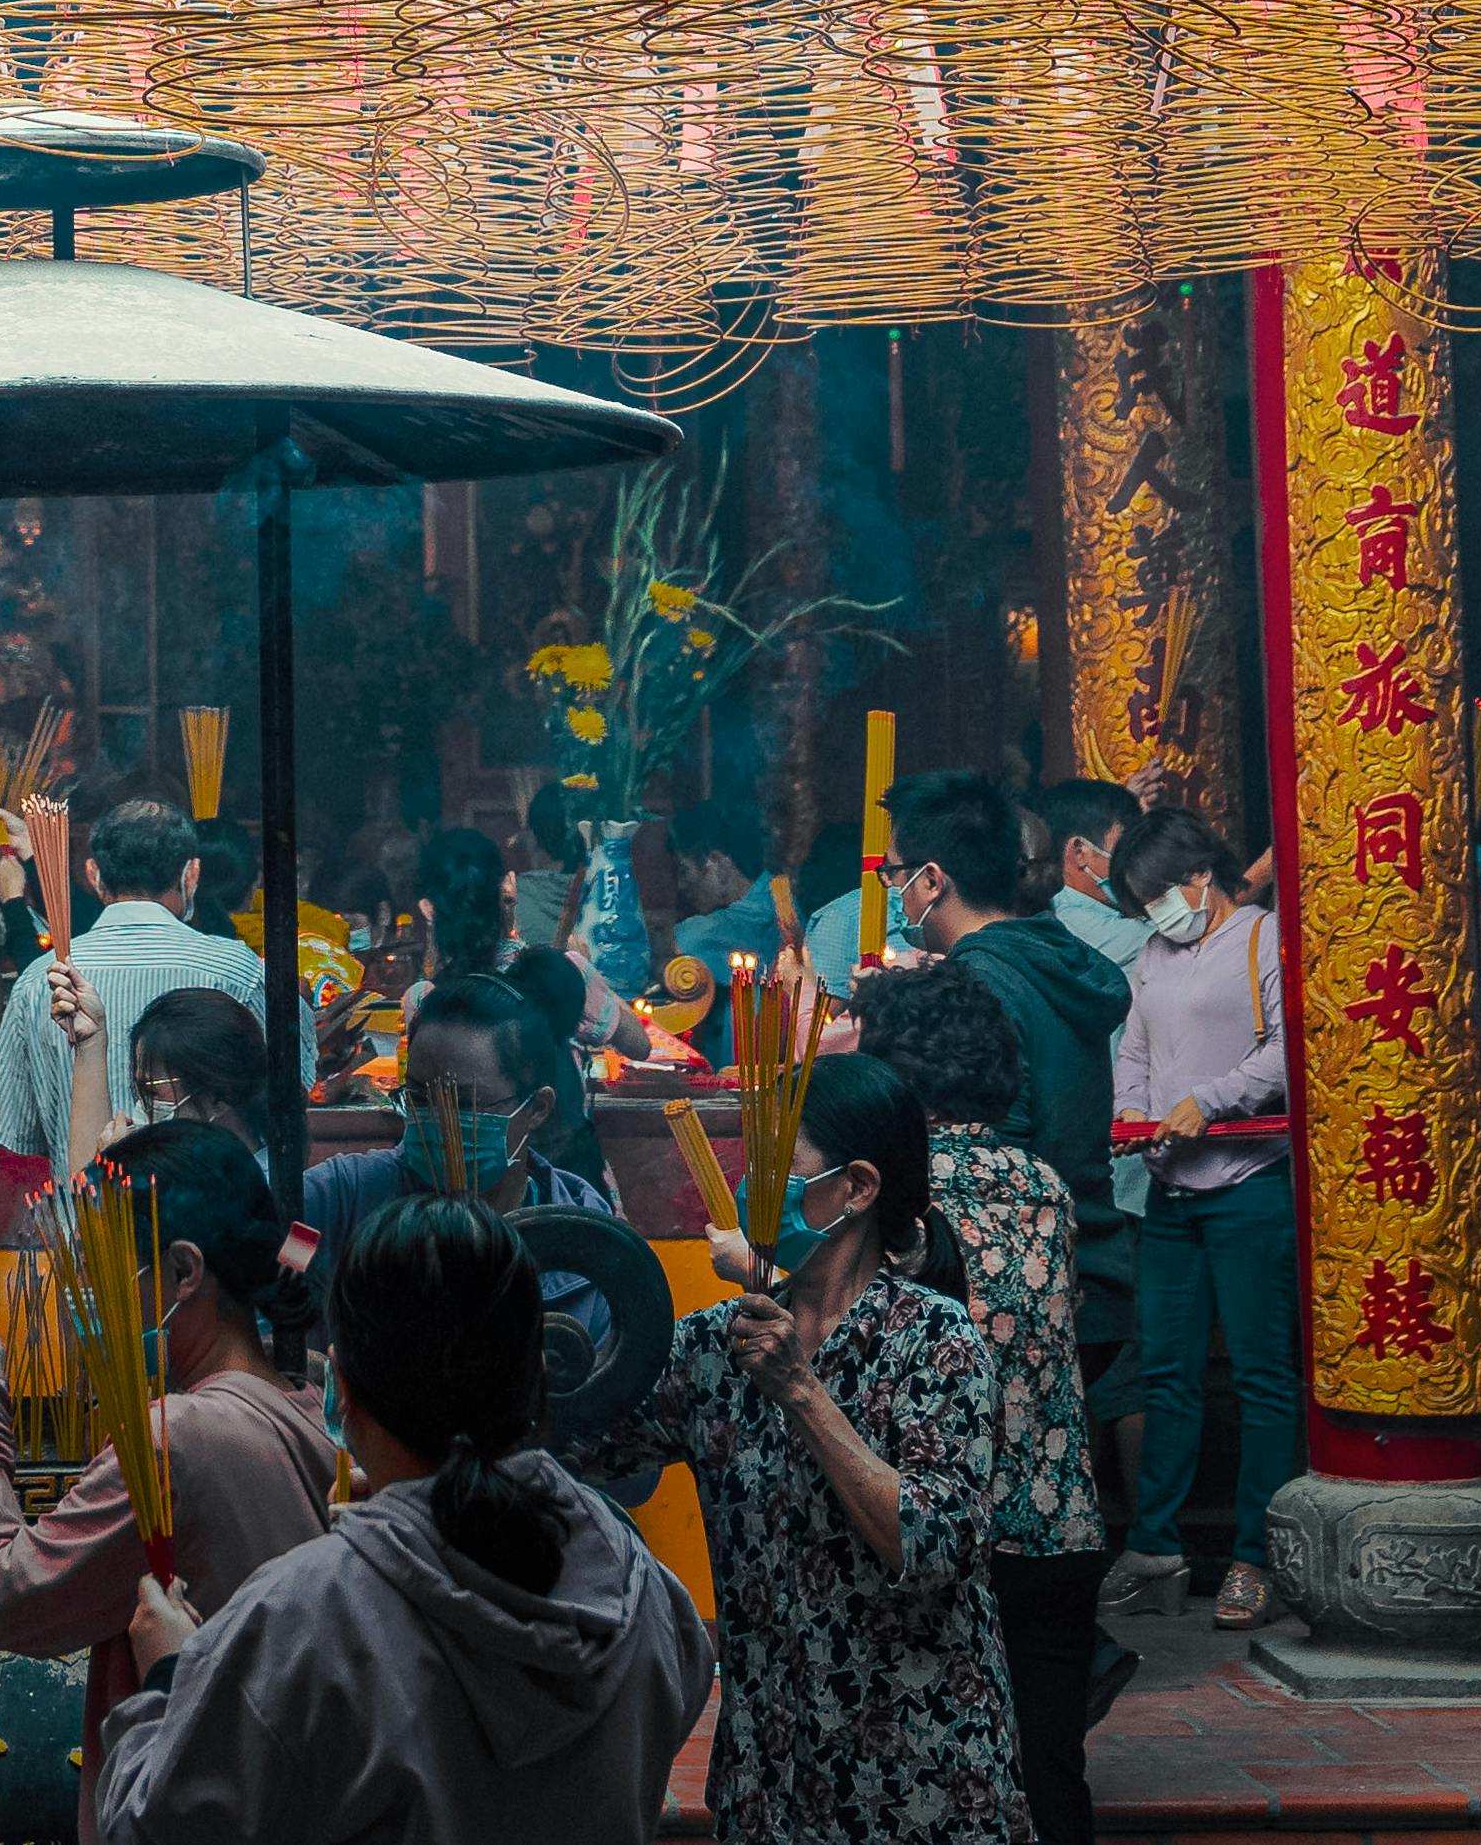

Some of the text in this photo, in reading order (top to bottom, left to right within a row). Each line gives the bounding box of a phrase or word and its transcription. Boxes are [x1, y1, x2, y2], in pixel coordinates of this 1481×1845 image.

[1337, 235, 1454, 1363] 道商旅同安輻輳
